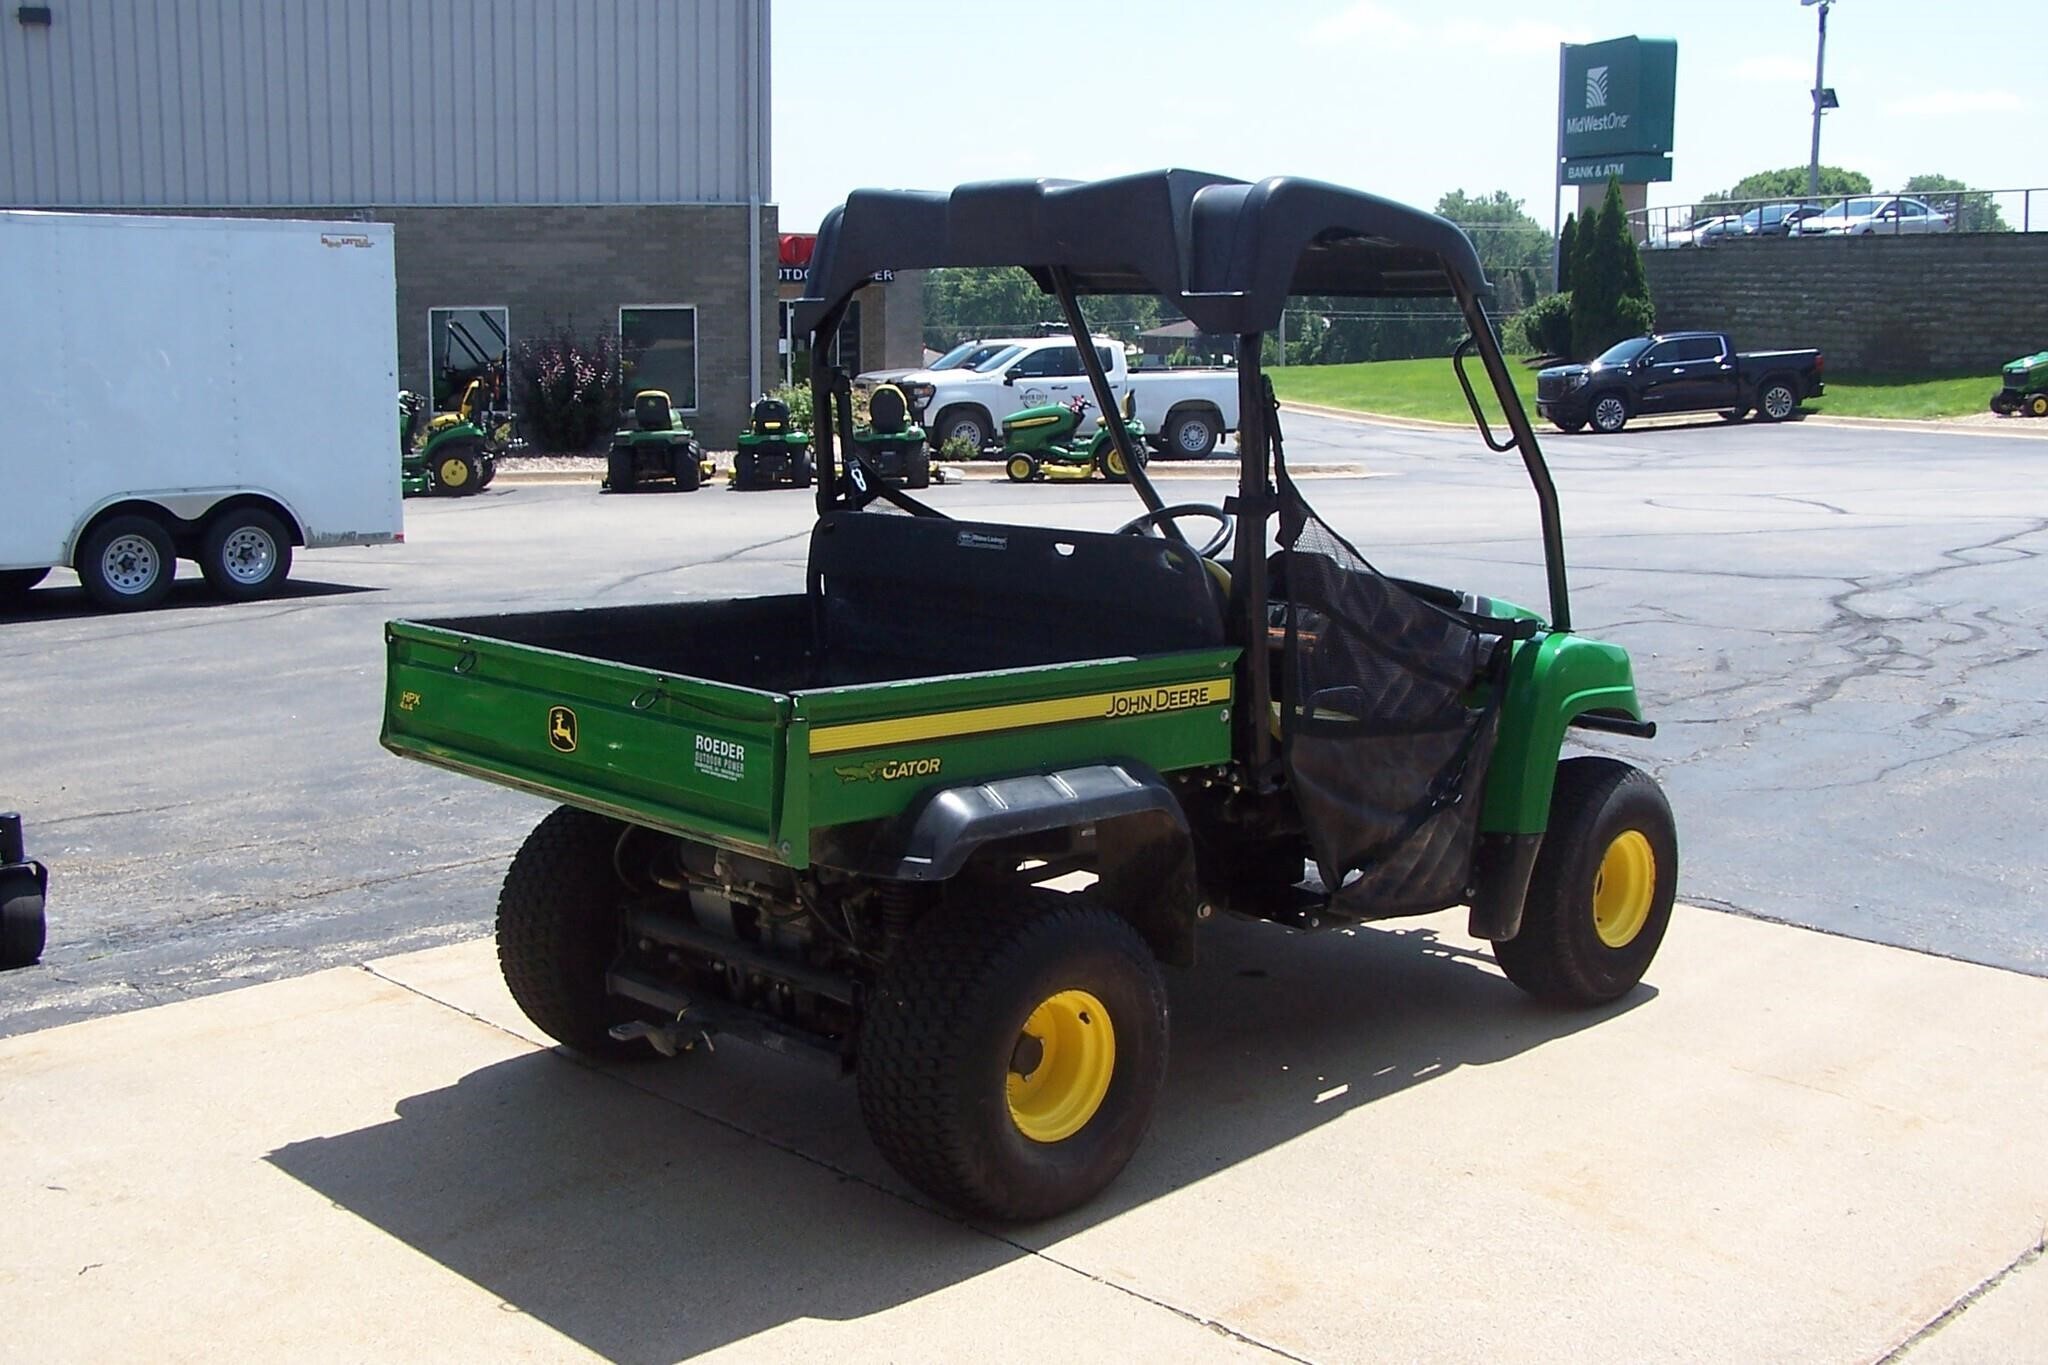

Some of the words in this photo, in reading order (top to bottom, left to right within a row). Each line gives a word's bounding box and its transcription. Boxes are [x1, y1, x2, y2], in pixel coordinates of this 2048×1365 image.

[1566, 111, 1628, 135] MidWestOne
[1567, 165, 1593, 179] BANK
[1595, 165, 1602, 178] &
[1603, 163, 1624, 177] ATM
[402, 691, 421, 705] HPX
[1106, 693, 1153, 716] JOHN
[1156, 687, 1209, 710] DEERE
[695, 734, 745, 761] ROEDER
[695, 751, 721, 767] OUTDOOR
[723, 758, 745, 773] POWER
[882, 757, 941, 780] GATOR
